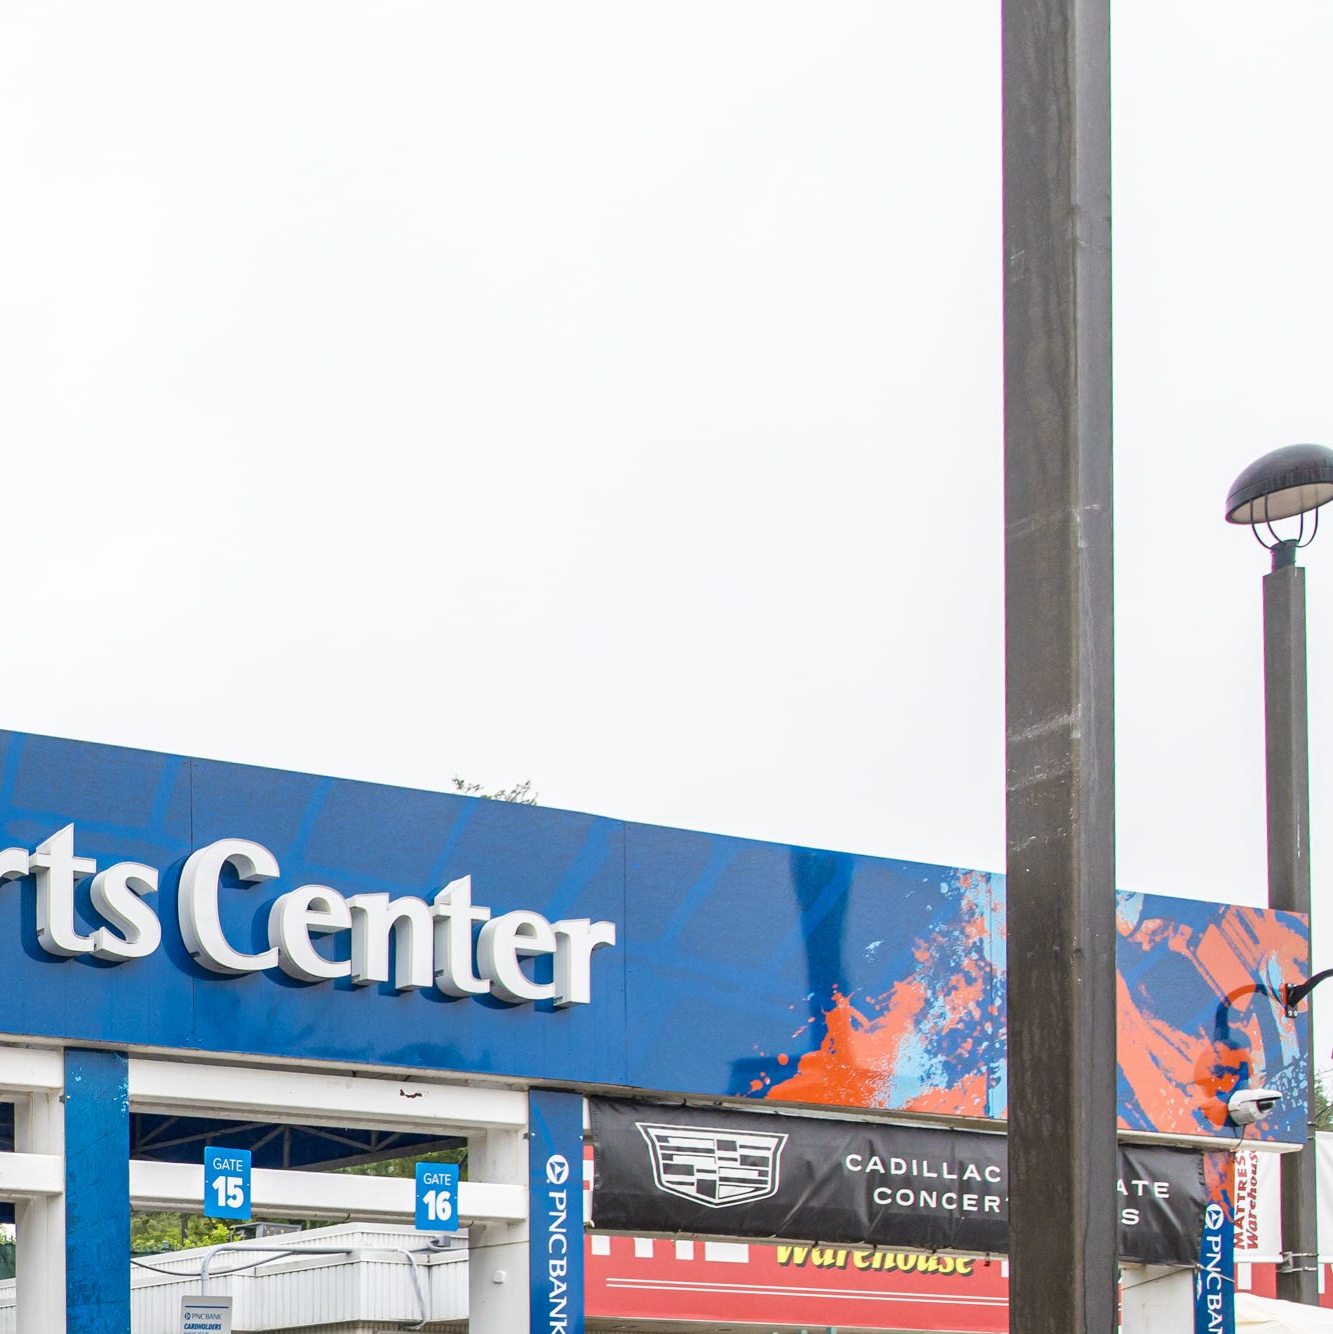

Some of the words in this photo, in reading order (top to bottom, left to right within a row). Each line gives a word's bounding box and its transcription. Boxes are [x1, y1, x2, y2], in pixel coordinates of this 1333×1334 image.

[177, 838, 616, 1007] Center
[213, 1157, 243, 1172] GATE
[423, 1173, 452, 1186] GATE
[845, 1154, 1001, 1181] CADILLAC
[212, 1176, 244, 1209] 15
[422, 1190, 452, 1221] 16
[873, 1188, 1010, 1214] CONCER
[548, 1190, 567, 1254] PNC
[1206, 1235, 1223, 1290] PNC
